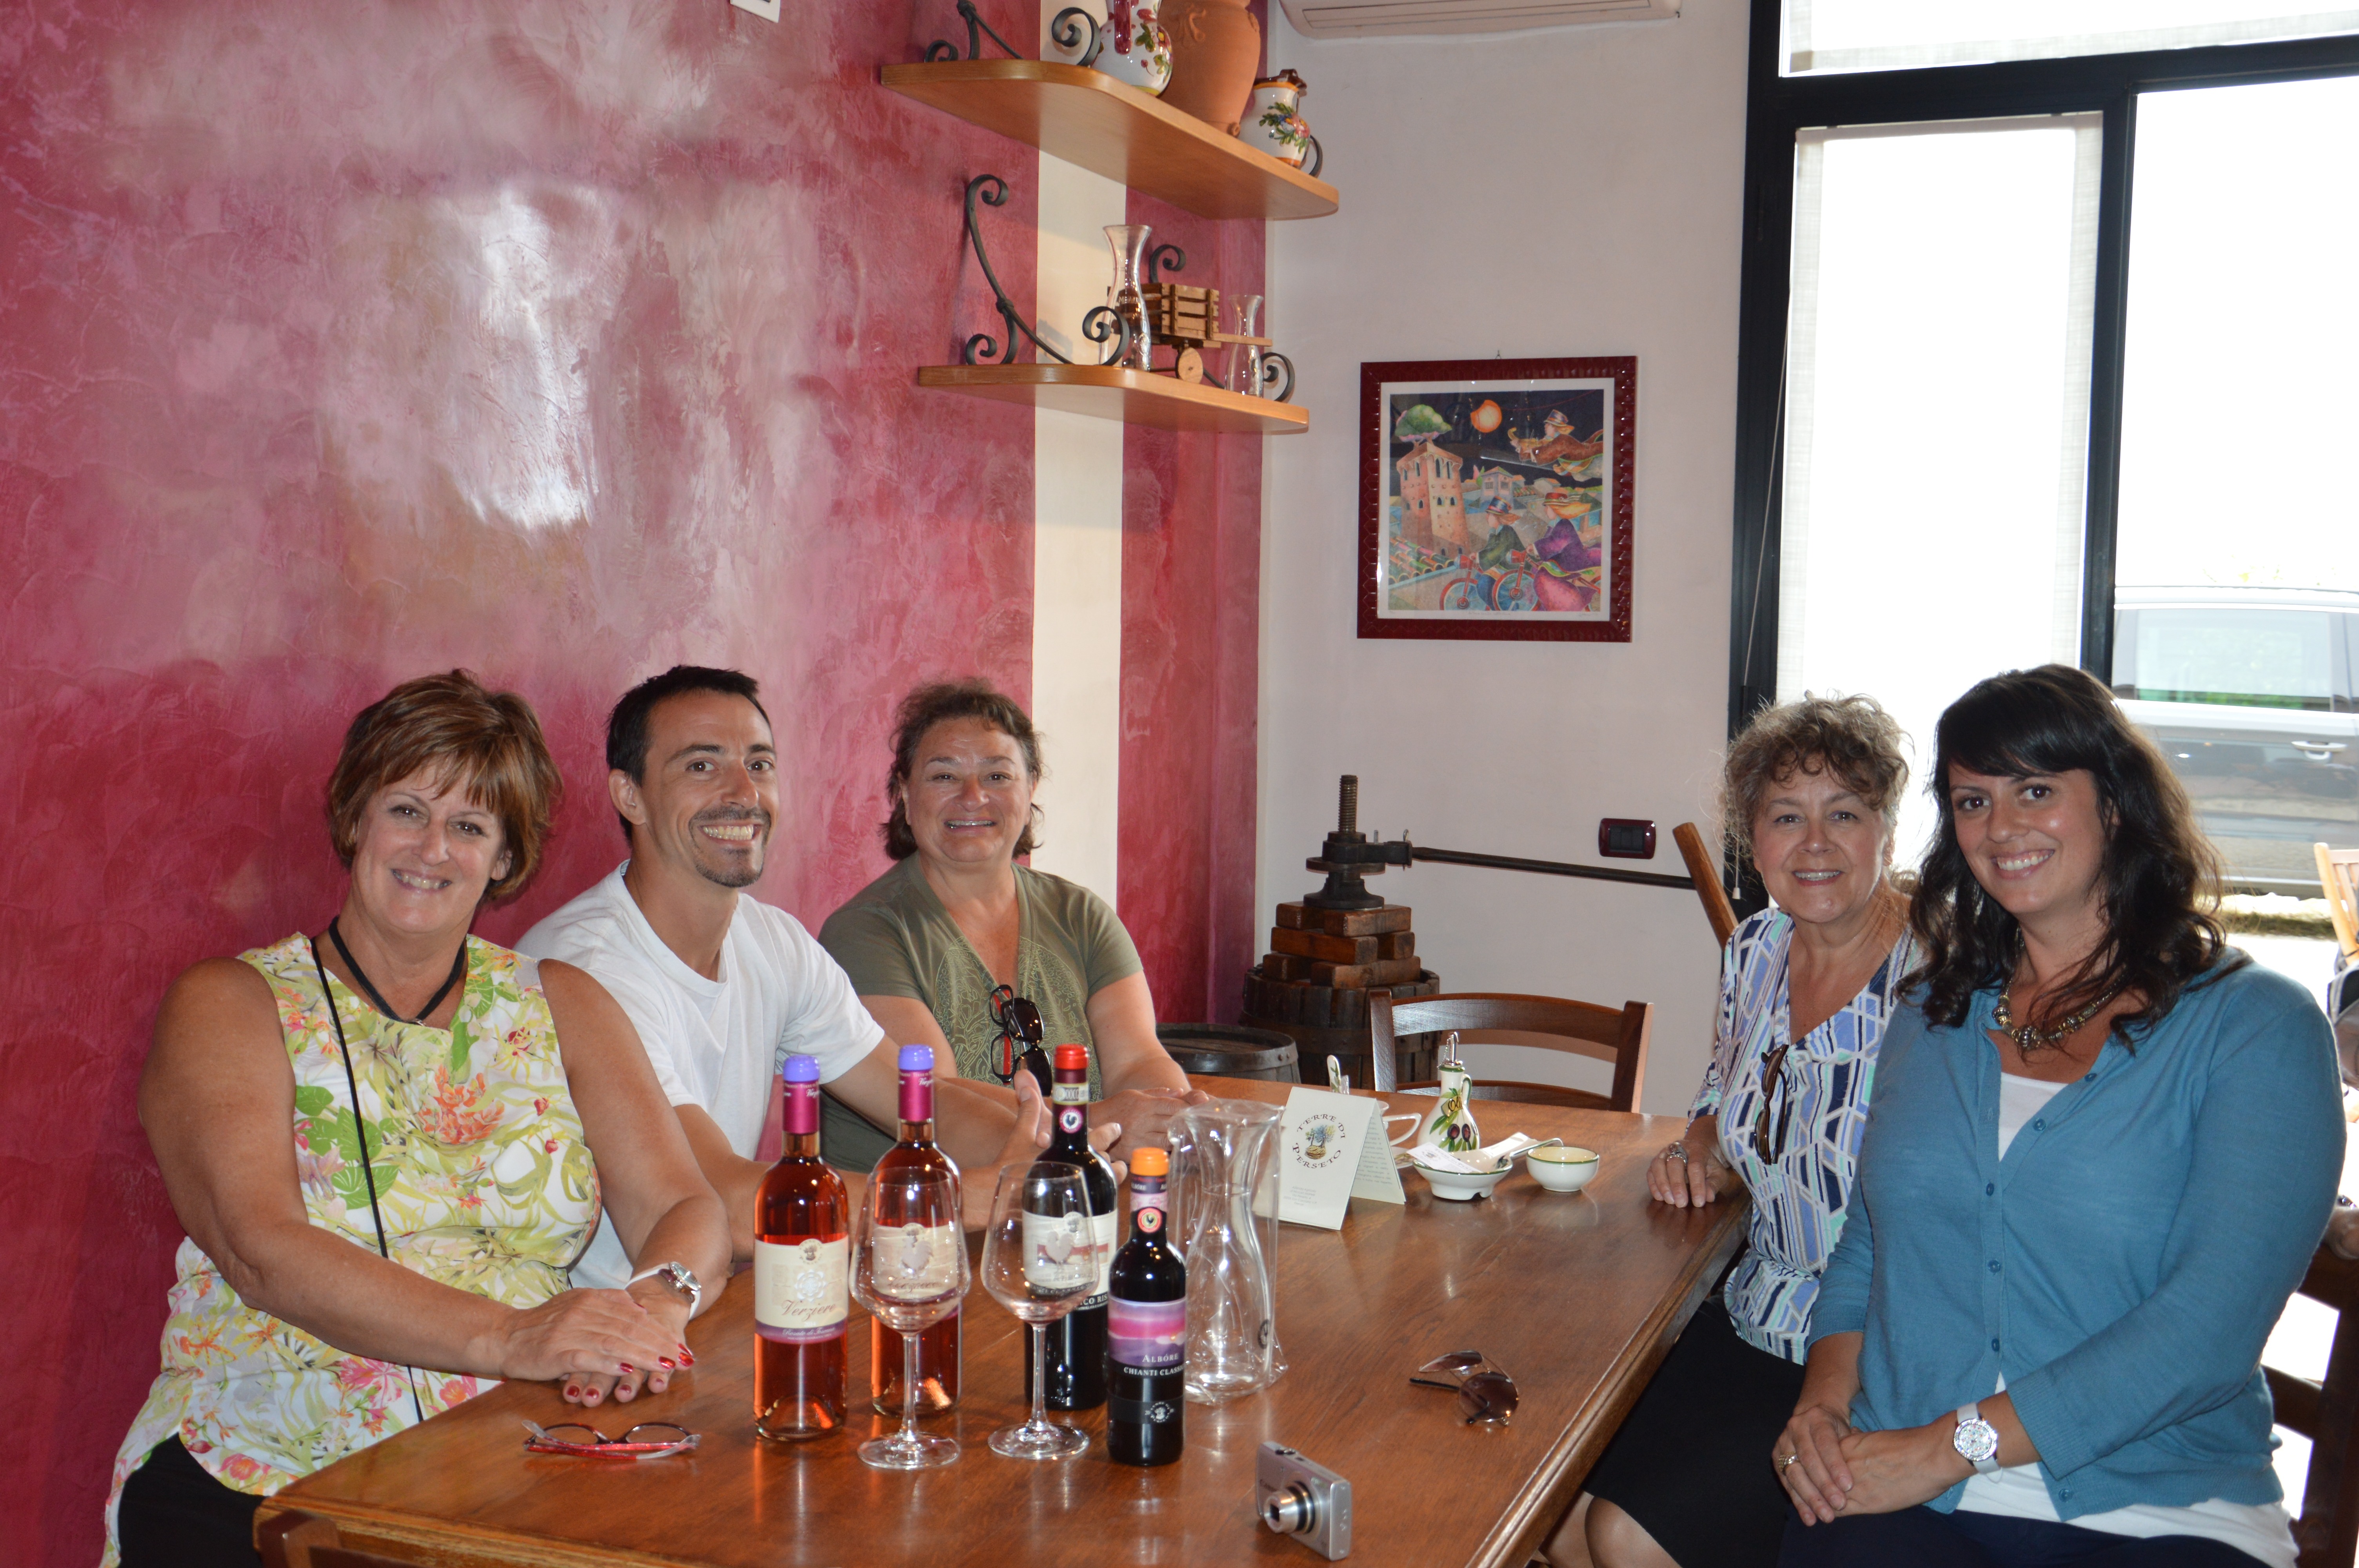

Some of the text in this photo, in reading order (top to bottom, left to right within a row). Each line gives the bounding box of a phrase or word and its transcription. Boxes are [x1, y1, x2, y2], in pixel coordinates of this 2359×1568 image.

[1297, 1114, 1345, 1138] TERRE DI
[1292, 1143, 1341, 1169] PERSETO
[781, 1299, 836, 1322] Verziere
[1142, 1353, 1179, 1363] ALBÓRE
[1124, 1367, 1158, 1376] CHIANTI
